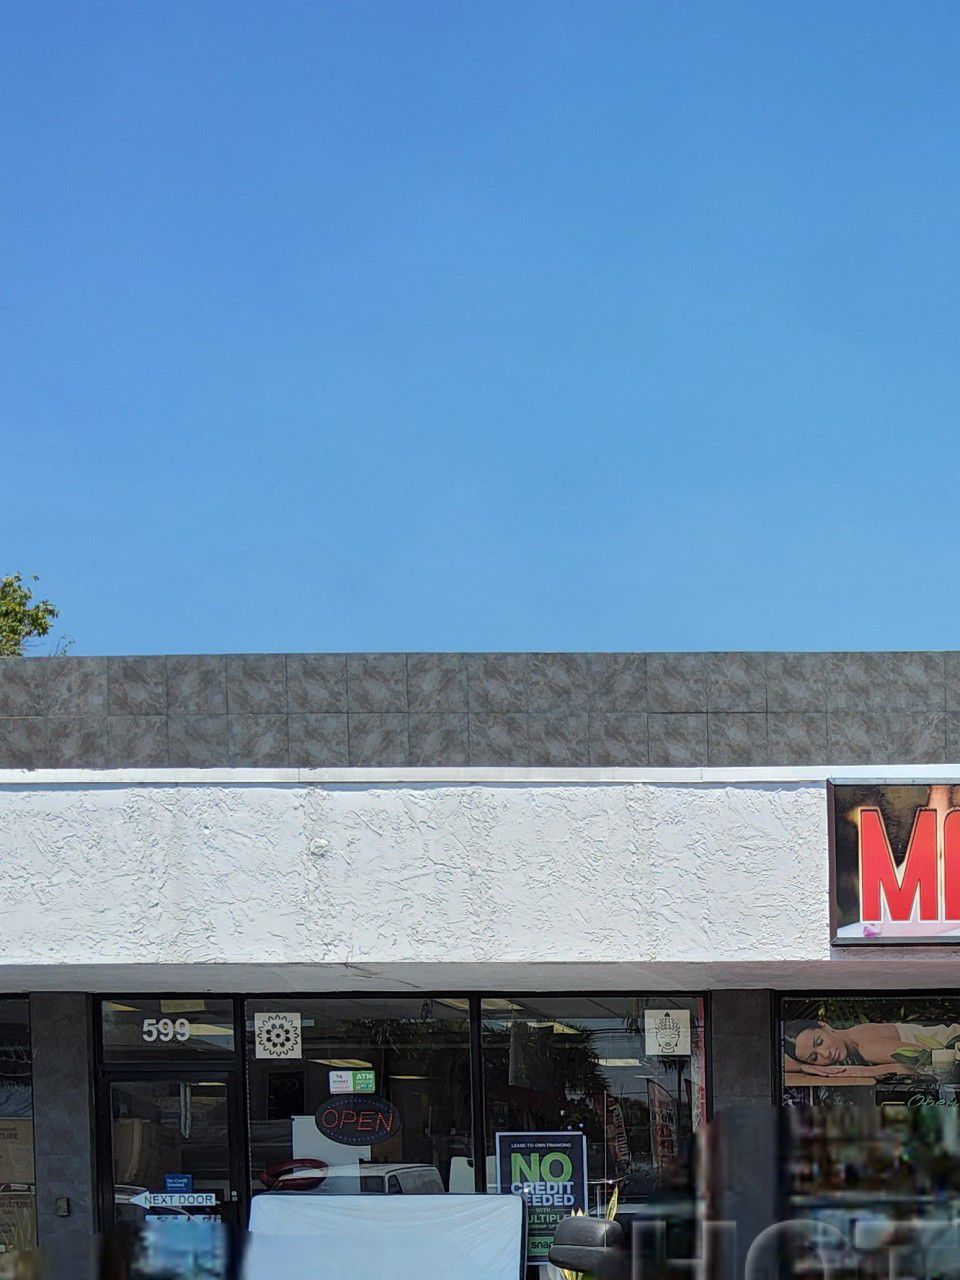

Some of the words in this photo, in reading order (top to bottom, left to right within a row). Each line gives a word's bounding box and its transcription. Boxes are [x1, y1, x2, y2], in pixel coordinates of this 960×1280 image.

[142, 1018, 191, 1042] 599
[322, 1109, 393, 1133] OPEN
[511, 1151, 573, 1184] NO
[510, 1181, 574, 1194] CREDIT
[145, 1195, 174, 1205] NEXT
[178, 1195, 213, 1205] DOOR
[525, 1194, 575, 1206] EEDED
